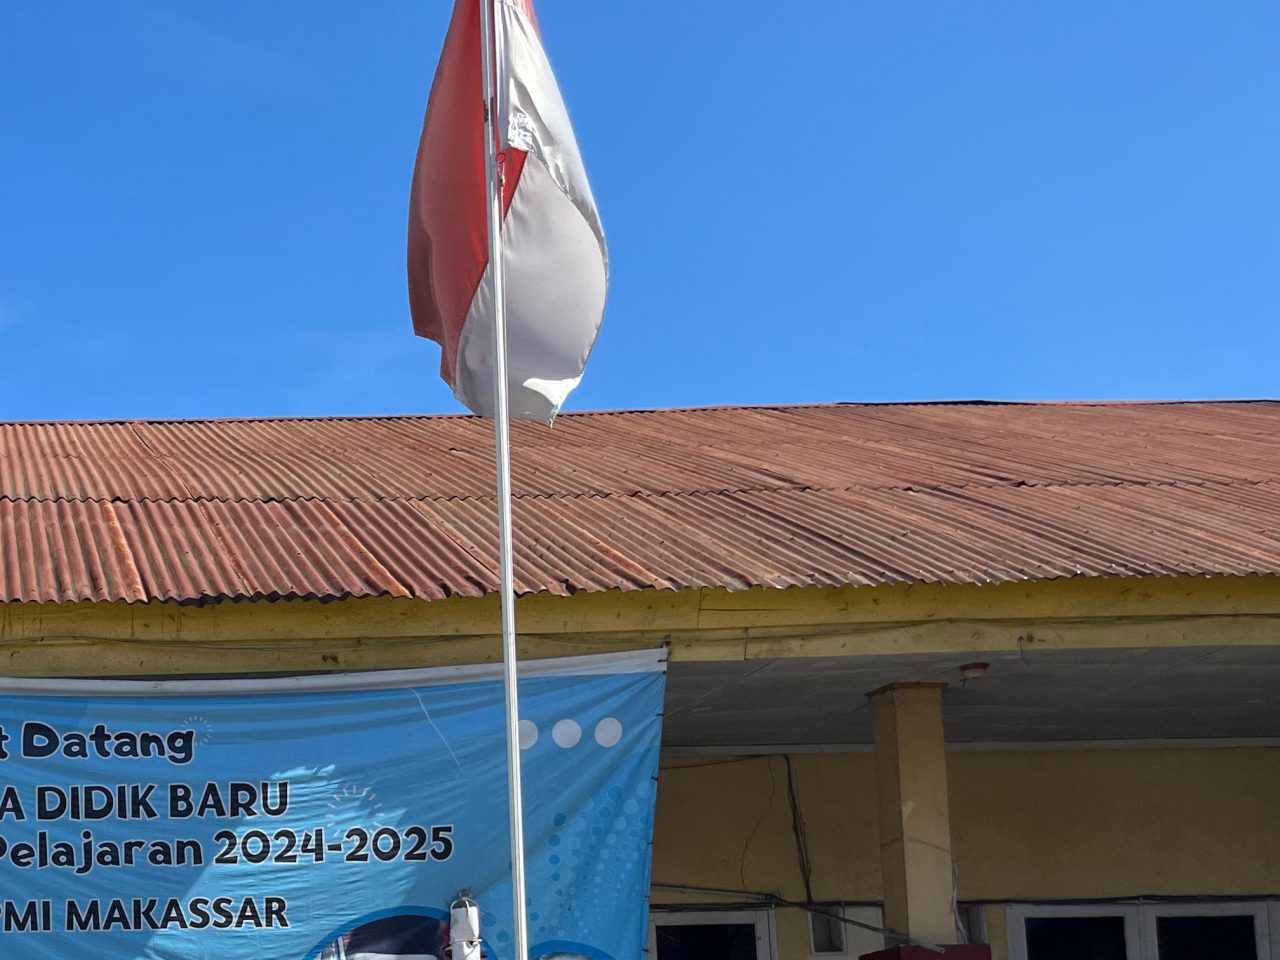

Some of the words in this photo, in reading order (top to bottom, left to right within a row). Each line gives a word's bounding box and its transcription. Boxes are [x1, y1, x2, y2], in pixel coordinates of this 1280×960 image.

[22, 721, 195, 765] Datang
[35, 783, 159, 821] DIDIK
[168, 780, 290, 820] BARU
[213, 824, 454, 865] 2024-2025
[65, 896, 291, 931] MAKASSAR
